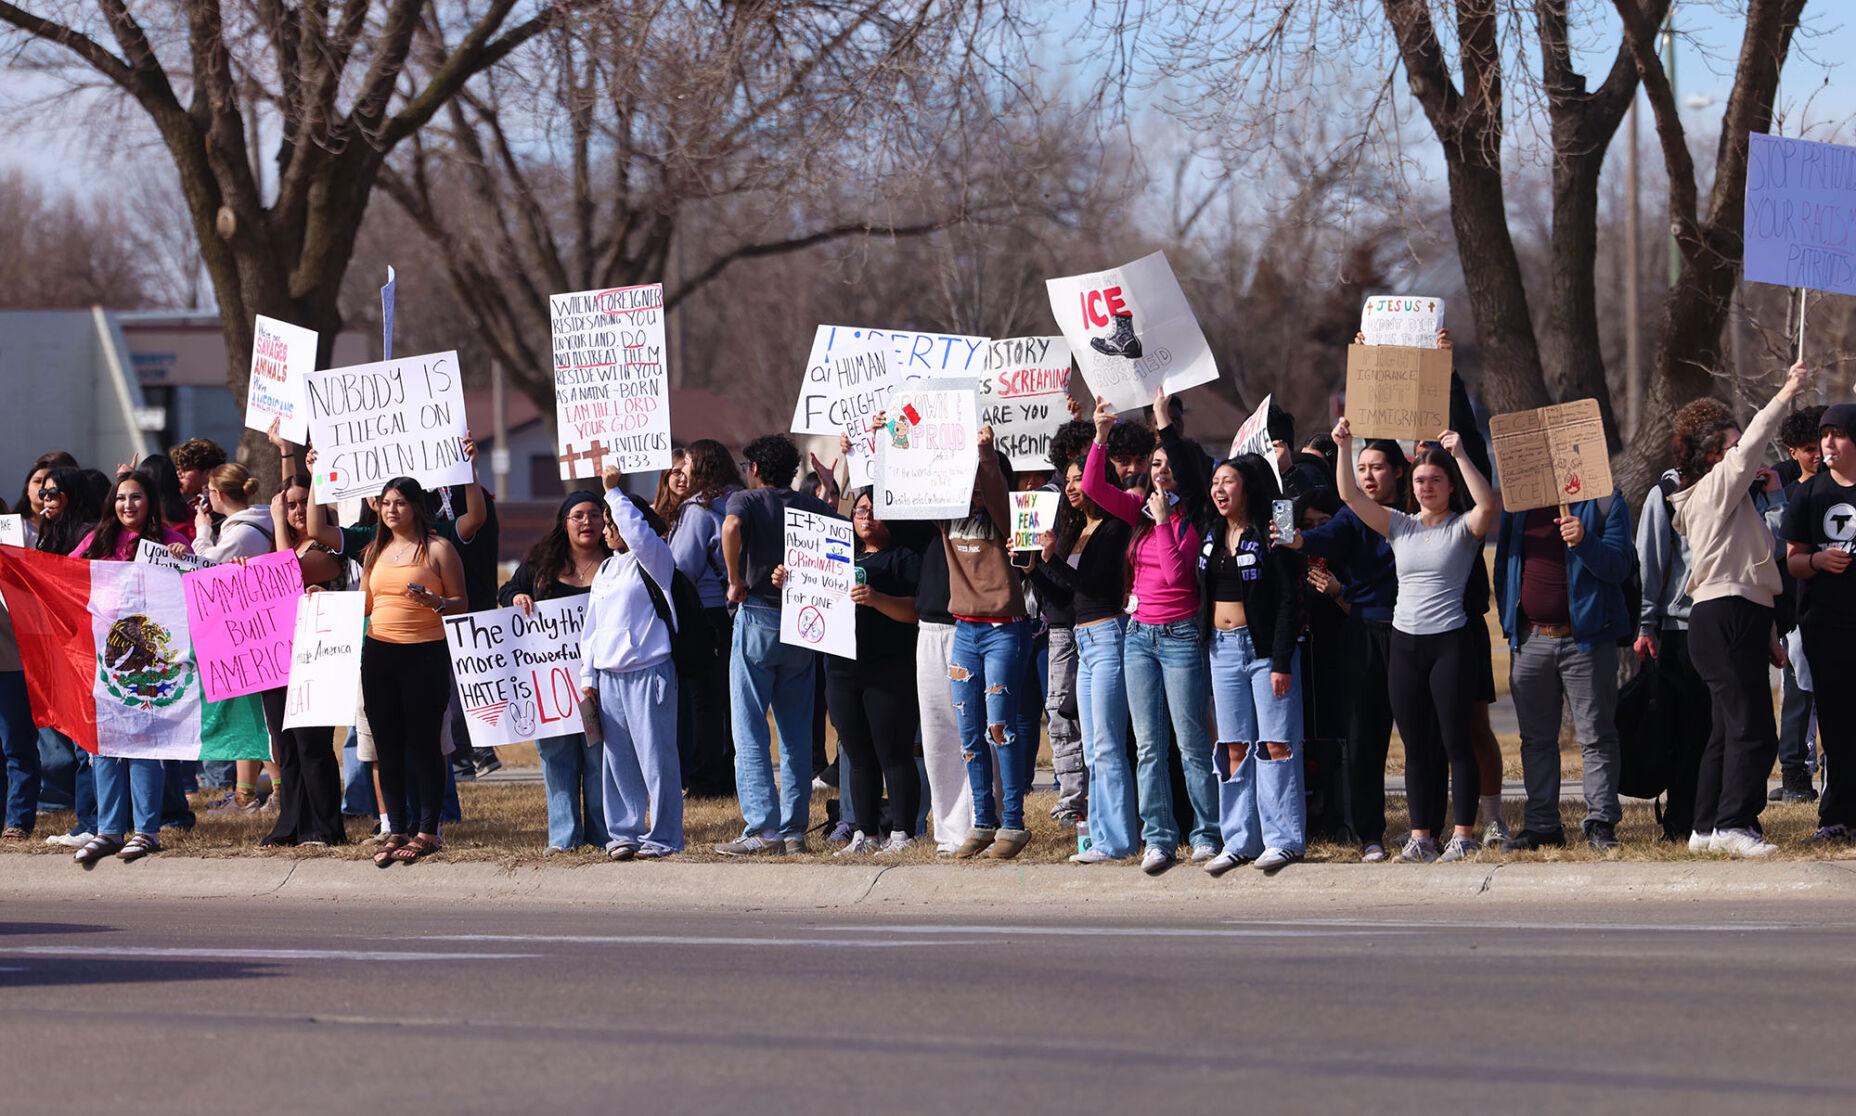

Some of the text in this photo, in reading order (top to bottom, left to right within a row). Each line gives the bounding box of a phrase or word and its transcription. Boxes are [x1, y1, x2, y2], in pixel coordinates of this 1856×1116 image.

[1749, 138, 1796, 191] STOP
[1749, 197, 1796, 241] YOUR
[1786, 243, 1856, 289] PATRIOTIS
[552, 296, 591, 316] WHEN
[601, 288, 662, 311] FOREIGNER
[1080, 286, 1133, 331] ICE
[1376, 300, 1421, 312] JESUS
[553, 315, 593, 334] RESIDES
[625, 310, 656, 326] YOU
[256, 337, 288, 362] SAVAGES
[565, 334, 586, 350] YOUR
[621, 329, 647, 348] DO
[555, 346, 660, 367] NOT MISTREAT THEM
[254, 357, 288, 383] ANIMALS
[556, 364, 662, 385] RESIDE WITH YOU
[836, 350, 886, 389] HUMAN
[998, 366, 1071, 396] SCREAMING
[1356, 369, 1417, 381] IGNORANCE
[308, 359, 451, 419] NOBODY IS
[556, 389, 569, 404] AS
[570, 387, 577, 402] A
[574, 403, 590, 422] AM
[614, 396, 657, 416] LORD
[982, 405, 1012, 426] ARE
[1020, 405, 1048, 420] YOU
[328, 401, 450, 448] ILLEGAL ON
[575, 413, 648, 440] YOUR GOD
[911, 423, 966, 451] PROUD
[608, 432, 667, 453] LEVITICUS
[995, 432, 1054, 464] istenin
[332, 436, 471, 491] STOLEN LAND
[617, 454, 650, 470] 19:33
[1015, 494, 1038, 509] WHY
[830, 525, 852, 541] NOT
[1018, 511, 1040, 530] FEAR
[1830, 514, 1853, 536] T
[144, 542, 168, 564] You
[179, 552, 200, 565] ont
[786, 532, 820, 552] About
[192, 558, 303, 621] IMMIGRANTS
[811, 595, 833, 610] ONE
[445, 616, 504, 649] The
[559, 605, 585, 635] thi
[315, 639, 352, 661] America
[456, 643, 582, 675] more Powerful
[461, 678, 508, 708] HATE
[510, 676, 532, 700] is
